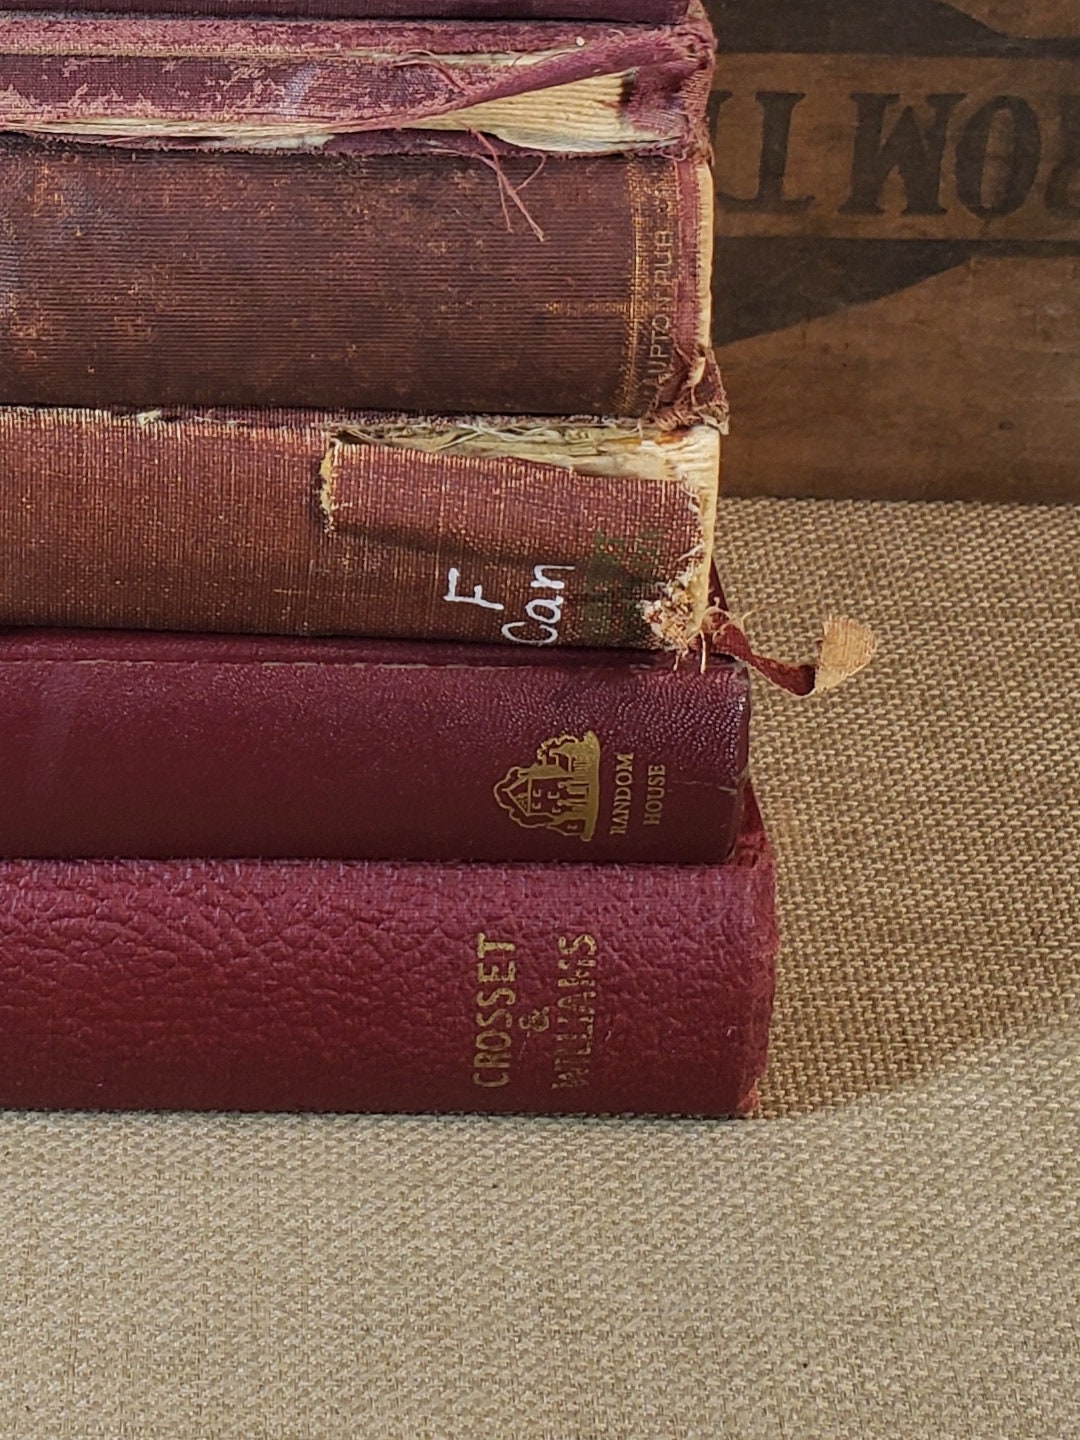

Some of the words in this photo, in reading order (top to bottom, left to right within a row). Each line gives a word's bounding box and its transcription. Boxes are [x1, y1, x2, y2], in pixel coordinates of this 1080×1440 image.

[443, 567, 504, 610] F
[501, 564, 576, 646] Can
[611, 752, 634, 835] RANDOM
[644, 764, 665, 825] HOUSE
[519, 1005, 550, 1034] &
